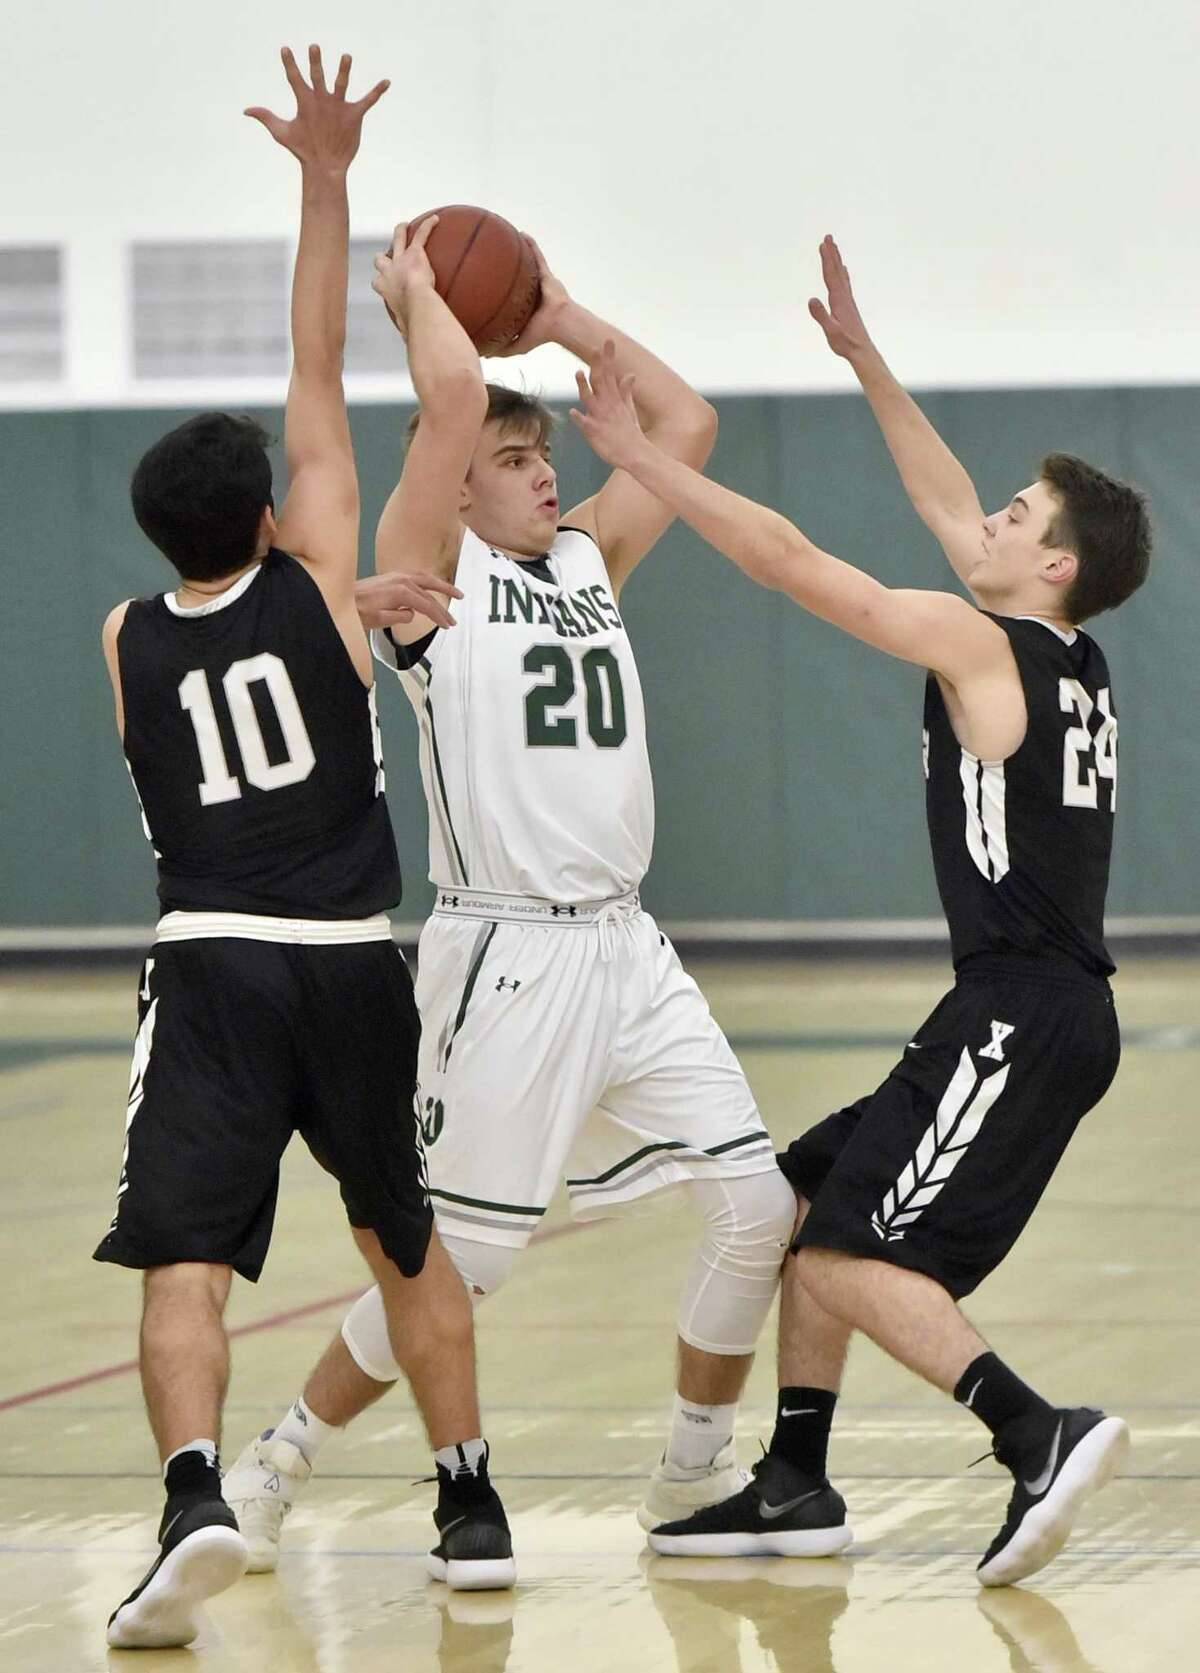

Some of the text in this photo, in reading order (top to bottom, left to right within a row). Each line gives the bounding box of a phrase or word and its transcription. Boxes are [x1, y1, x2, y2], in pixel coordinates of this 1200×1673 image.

[178, 652, 317, 807] 10
[521, 642, 628, 750] 20
[1059, 677, 1118, 813] 24
[462, 899, 548, 914] UNDER ARMOUR
[977, 1019, 1016, 1062] X
